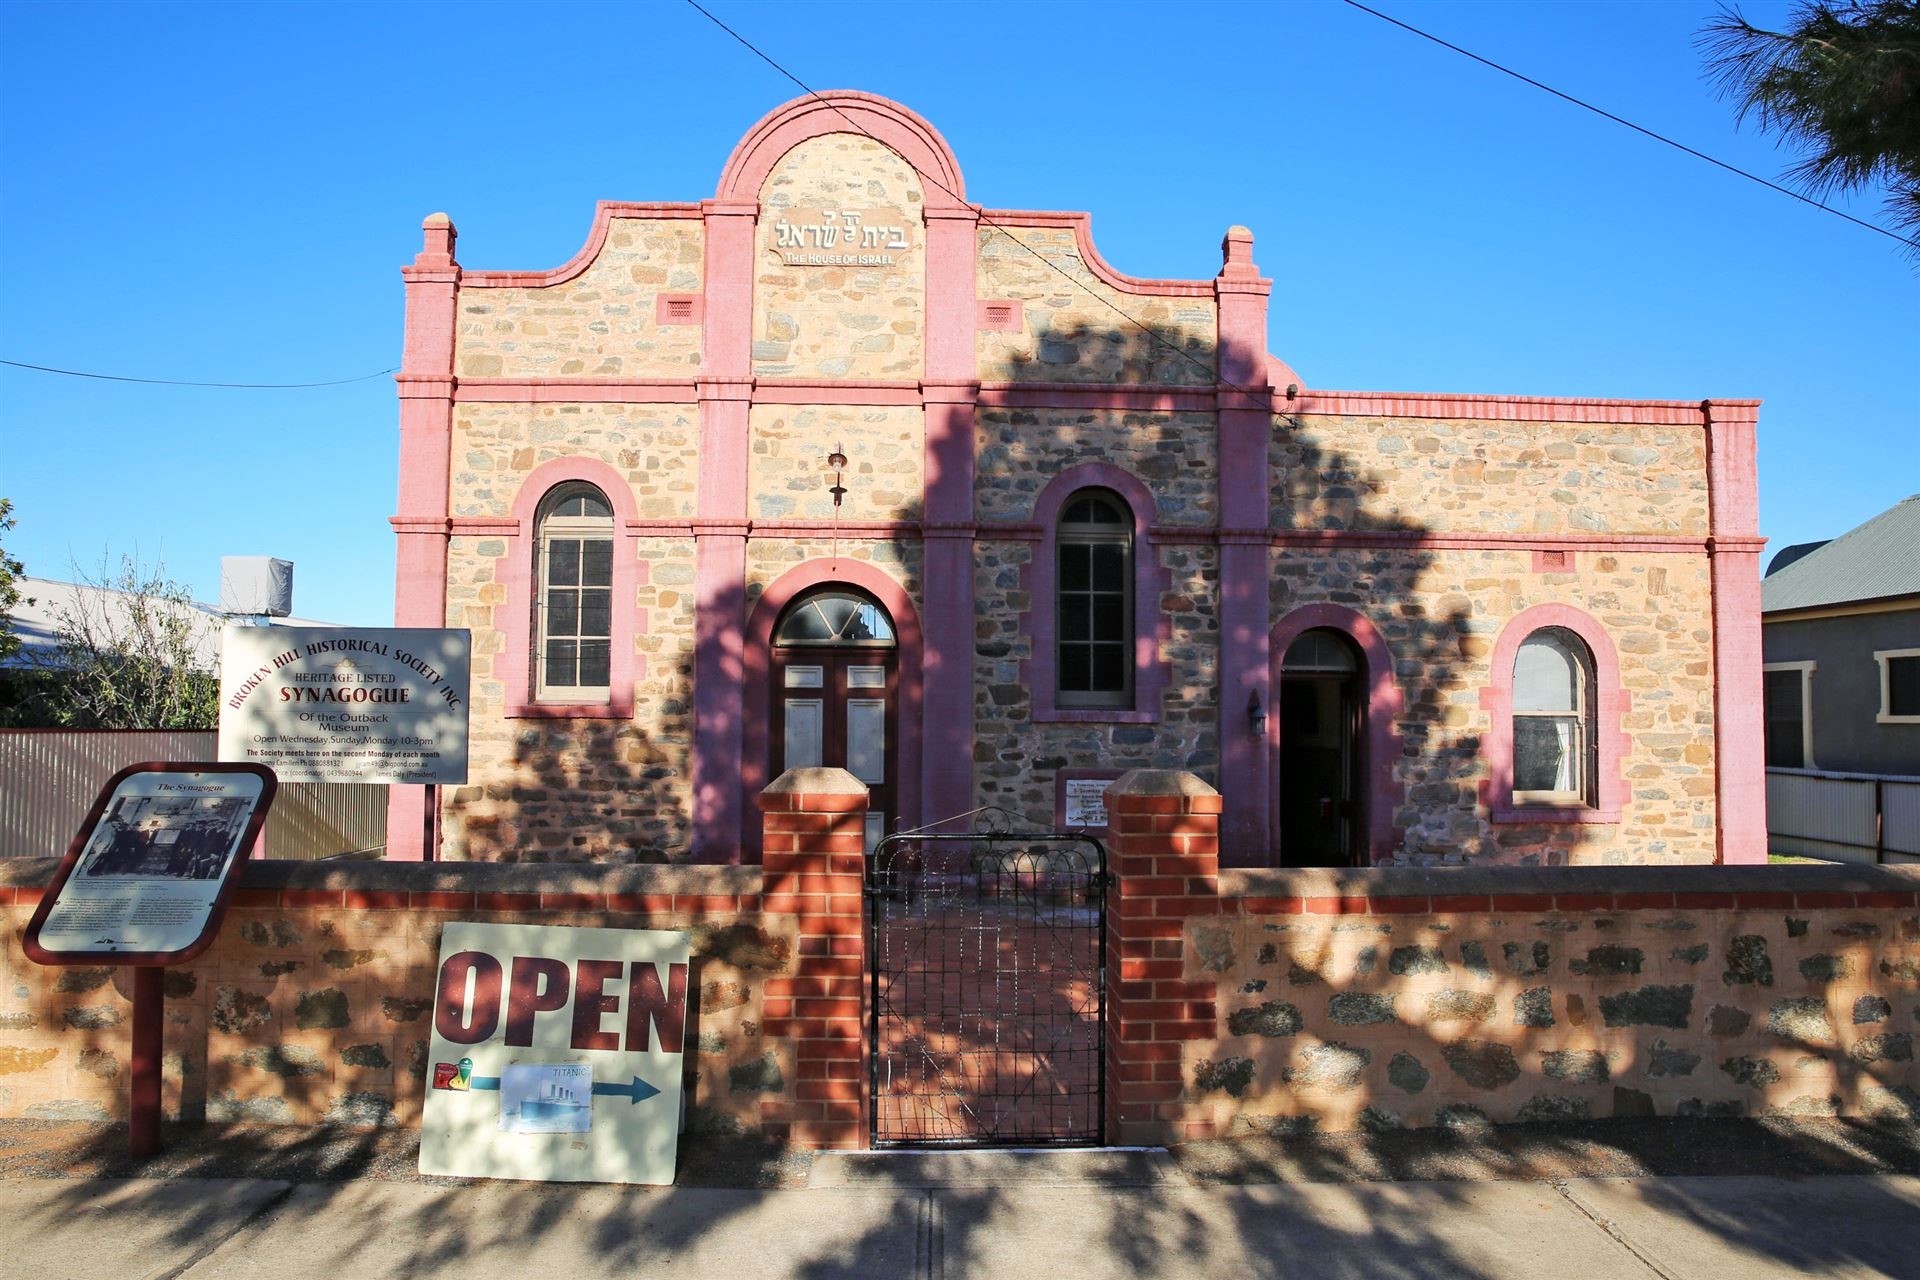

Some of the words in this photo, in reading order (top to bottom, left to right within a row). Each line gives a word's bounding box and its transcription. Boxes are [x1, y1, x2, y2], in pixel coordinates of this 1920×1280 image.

[785, 252, 807, 264] THE
[808, 253, 842, 264] HOUSE
[842, 254, 858, 265] OF
[858, 254, 895, 265] ISRAEL
[229, 665, 272, 709] BROKEN
[273, 649, 302, 669] HILL
[306, 639, 388, 656] HISTORICAL
[393, 649, 443, 685] SOCIETY
[440, 685, 461, 711] INC.
[295, 673, 353, 683] HERITAGE
[357, 674, 396, 683] LISTED
[280, 686, 410, 704] SYNAGOGUE
[300, 712, 313, 722] Of
[317, 713, 336, 722] the
[340, 713, 389, 723] Outback
[318, 723, 370, 732] Museum
[254, 735, 277, 744] Open
[401, 737, 433, 746] 10-3pm
[247, 749, 259, 757] The
[260, 749, 283, 758] Society
[368, 751, 393, 759] Monday
[157, 783, 175, 791] The
[176, 783, 225, 793] Synagogue
[434, 951, 688, 1054] OPEN
[553, 1068, 587, 1078] TITANIC
